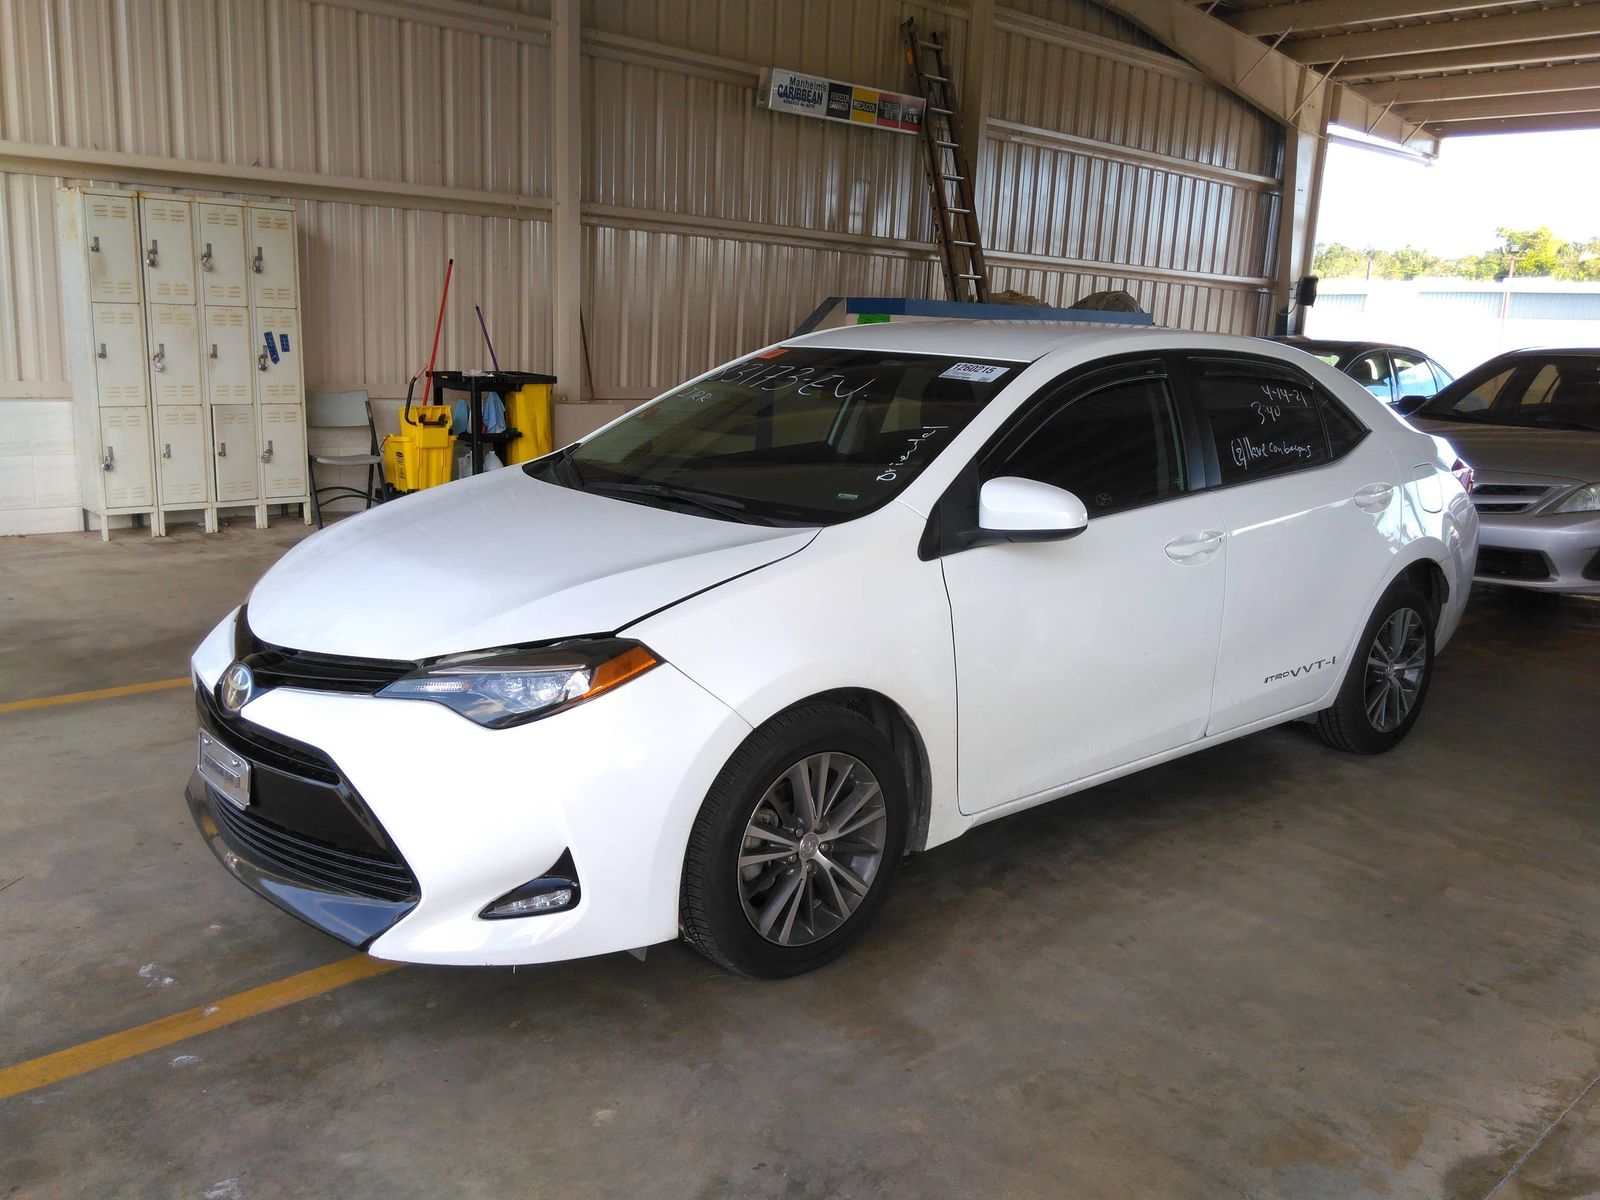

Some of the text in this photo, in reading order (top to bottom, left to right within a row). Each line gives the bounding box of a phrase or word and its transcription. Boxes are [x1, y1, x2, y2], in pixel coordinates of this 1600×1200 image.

[777, 84, 823, 105] CARIBBEAN
[953, 363, 997, 374] 1260215
[1261, 385, 1308, 407] 4-14-21
[1290, 656, 1336, 677] VVT-I
